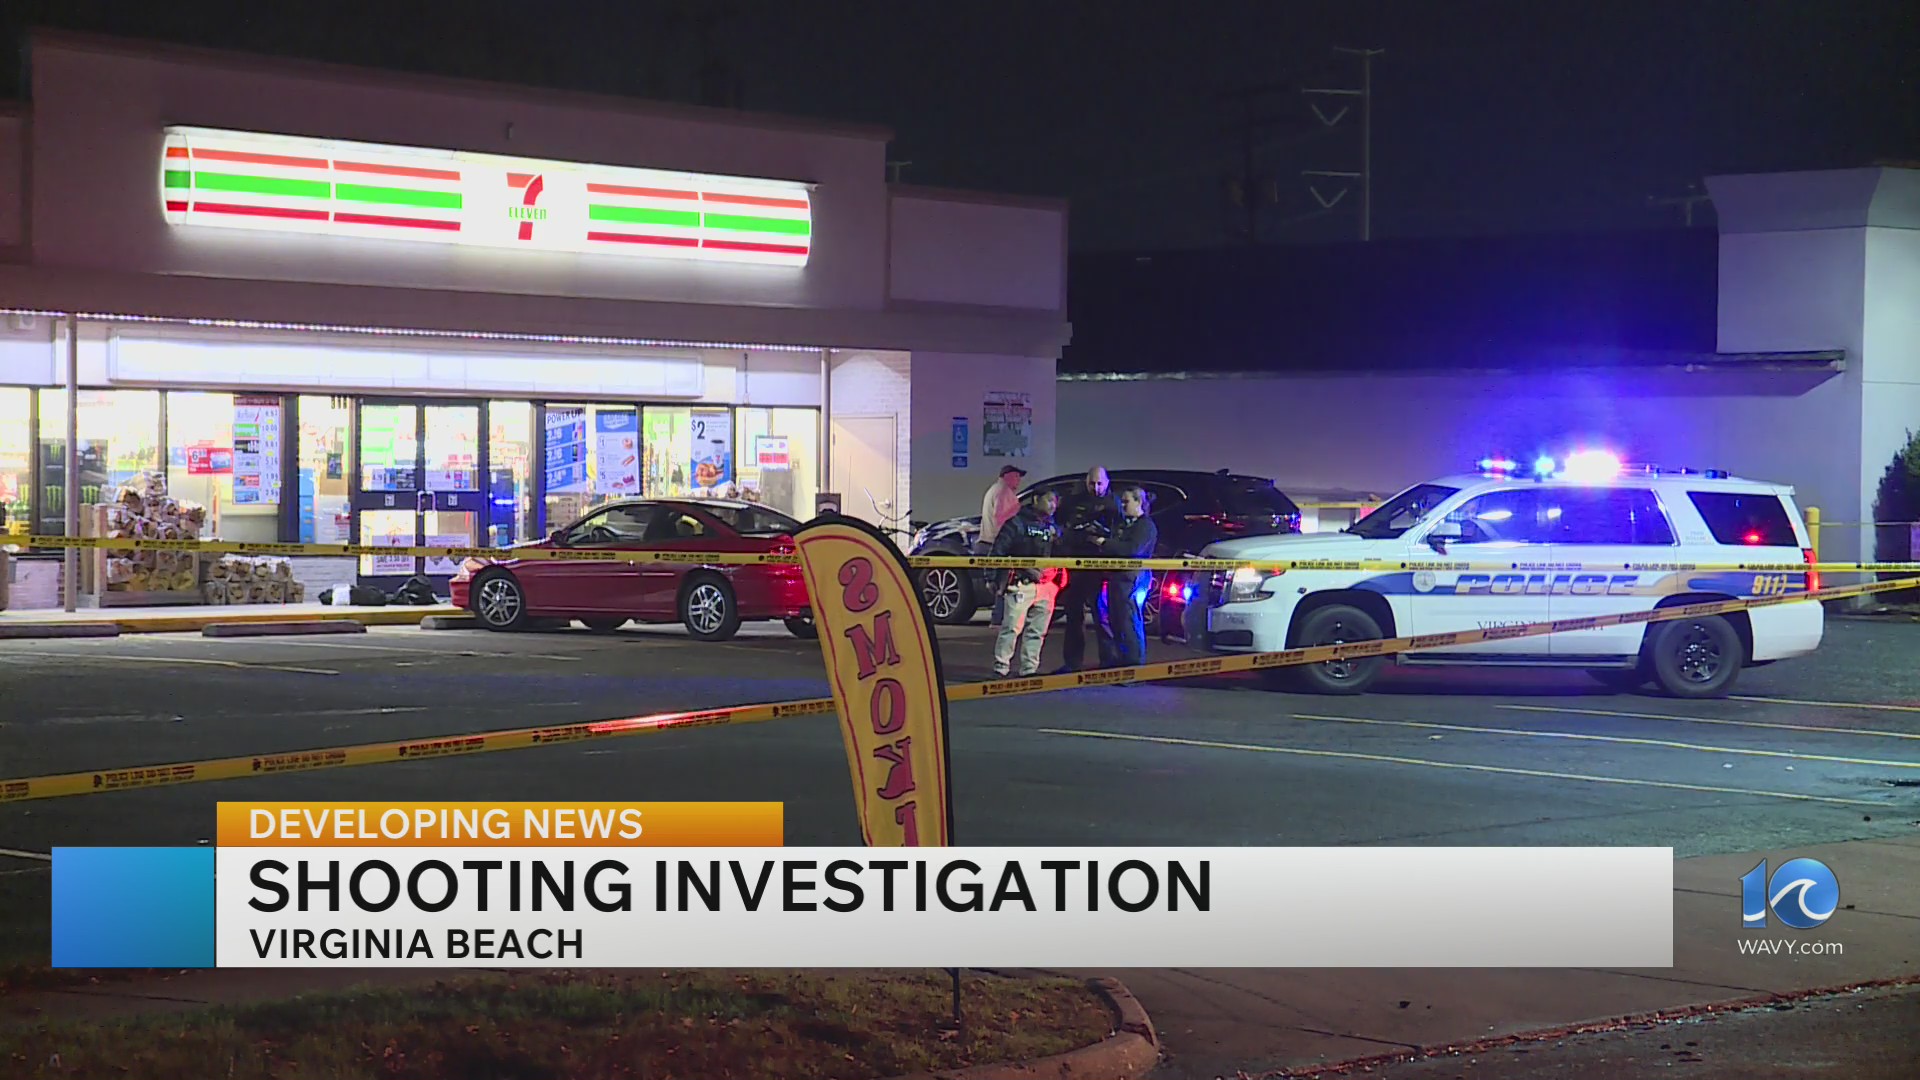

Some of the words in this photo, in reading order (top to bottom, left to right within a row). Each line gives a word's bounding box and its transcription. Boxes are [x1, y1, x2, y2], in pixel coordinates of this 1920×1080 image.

[506, 172, 543, 240] 7
[691, 419, 705, 440] $2
[1455, 574, 1639, 595] POLICE
